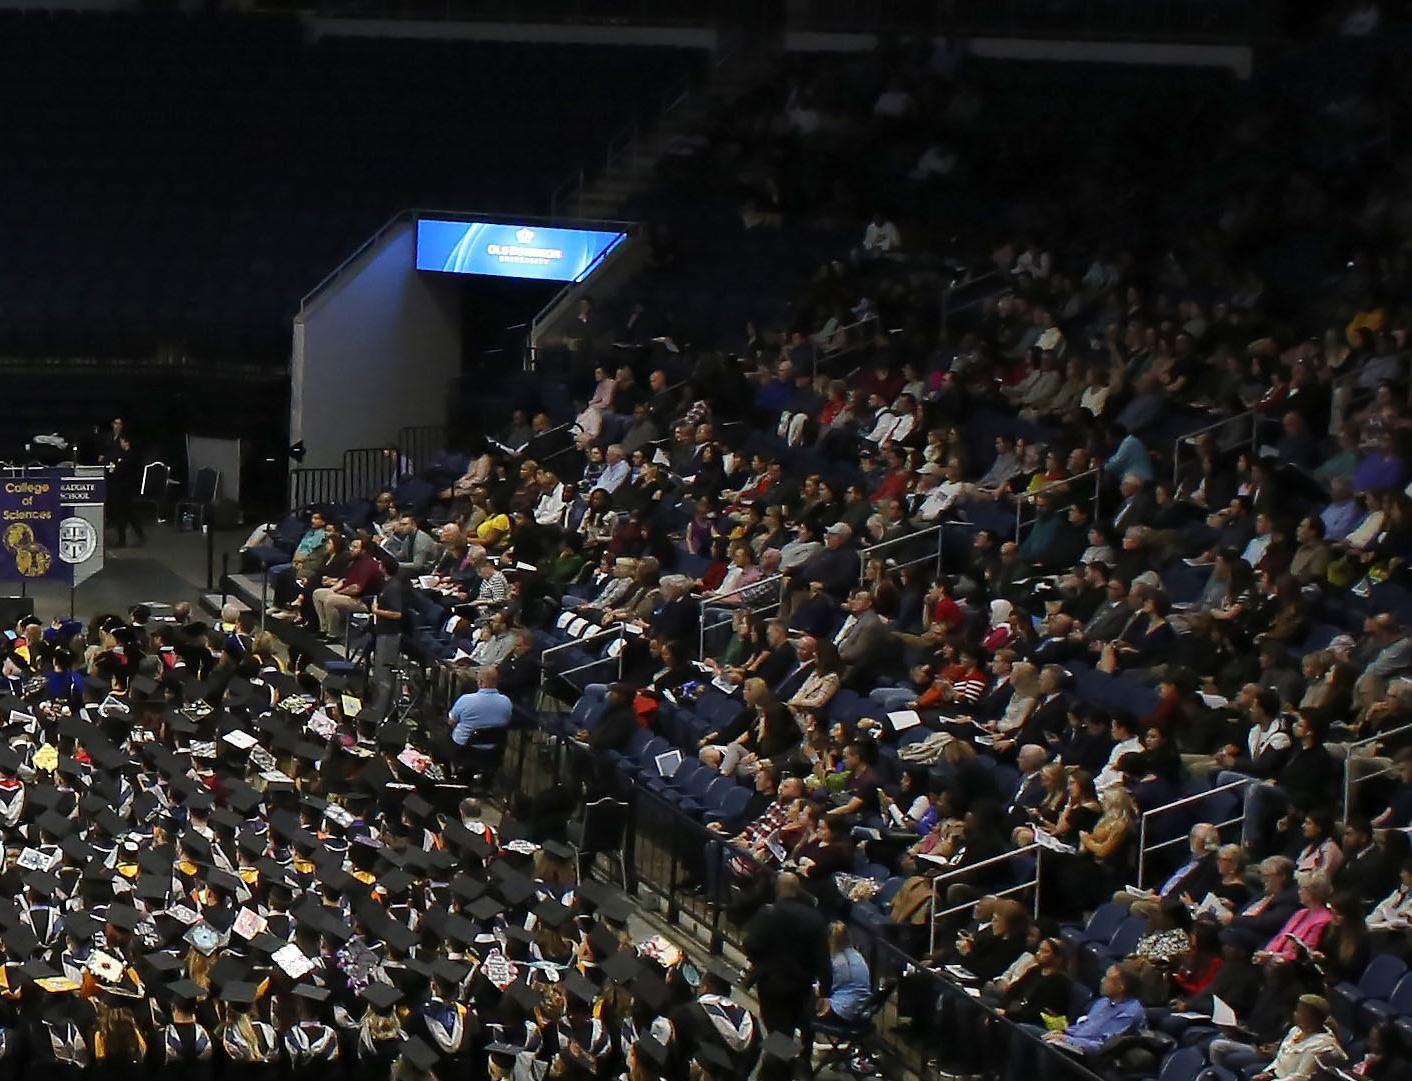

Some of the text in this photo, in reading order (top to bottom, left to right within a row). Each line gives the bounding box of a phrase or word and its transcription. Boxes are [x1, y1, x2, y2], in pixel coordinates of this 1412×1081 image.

[5, 482, 50, 495] College
[21, 495, 34, 506] of
[59, 492, 90, 500] SCHOOL
[2, 510, 52, 520] Sciences
